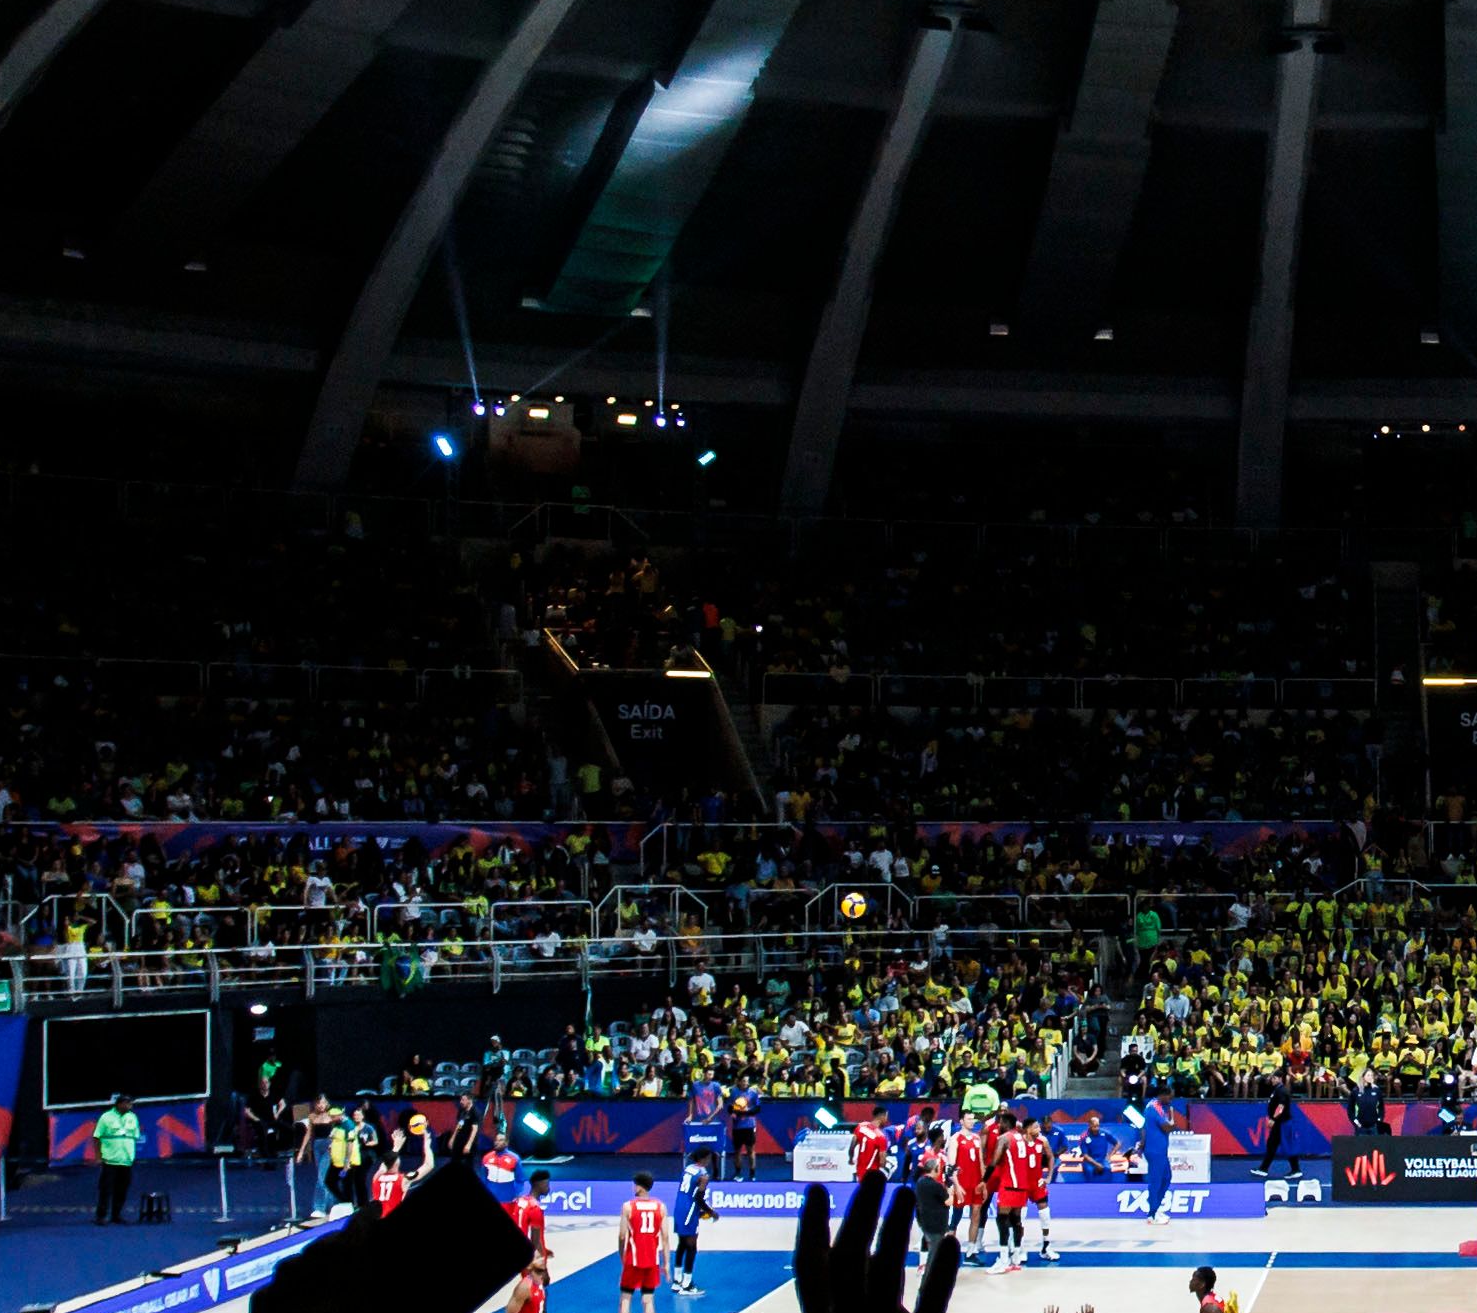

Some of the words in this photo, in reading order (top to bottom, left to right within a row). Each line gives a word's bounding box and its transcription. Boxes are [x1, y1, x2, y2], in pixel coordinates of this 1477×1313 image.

[618, 698, 676, 720] SAÍDA
[630, 723, 663, 740] Exit
[1345, 1149, 1396, 1186] VNL
[1405, 1169, 1444, 1178] NATIONS
[711, 1191, 762, 1208] BANCO
[763, 1191, 785, 1208] DO
[785, 1191, 836, 1208] BRL
[640, 1212, 655, 1233] 11
